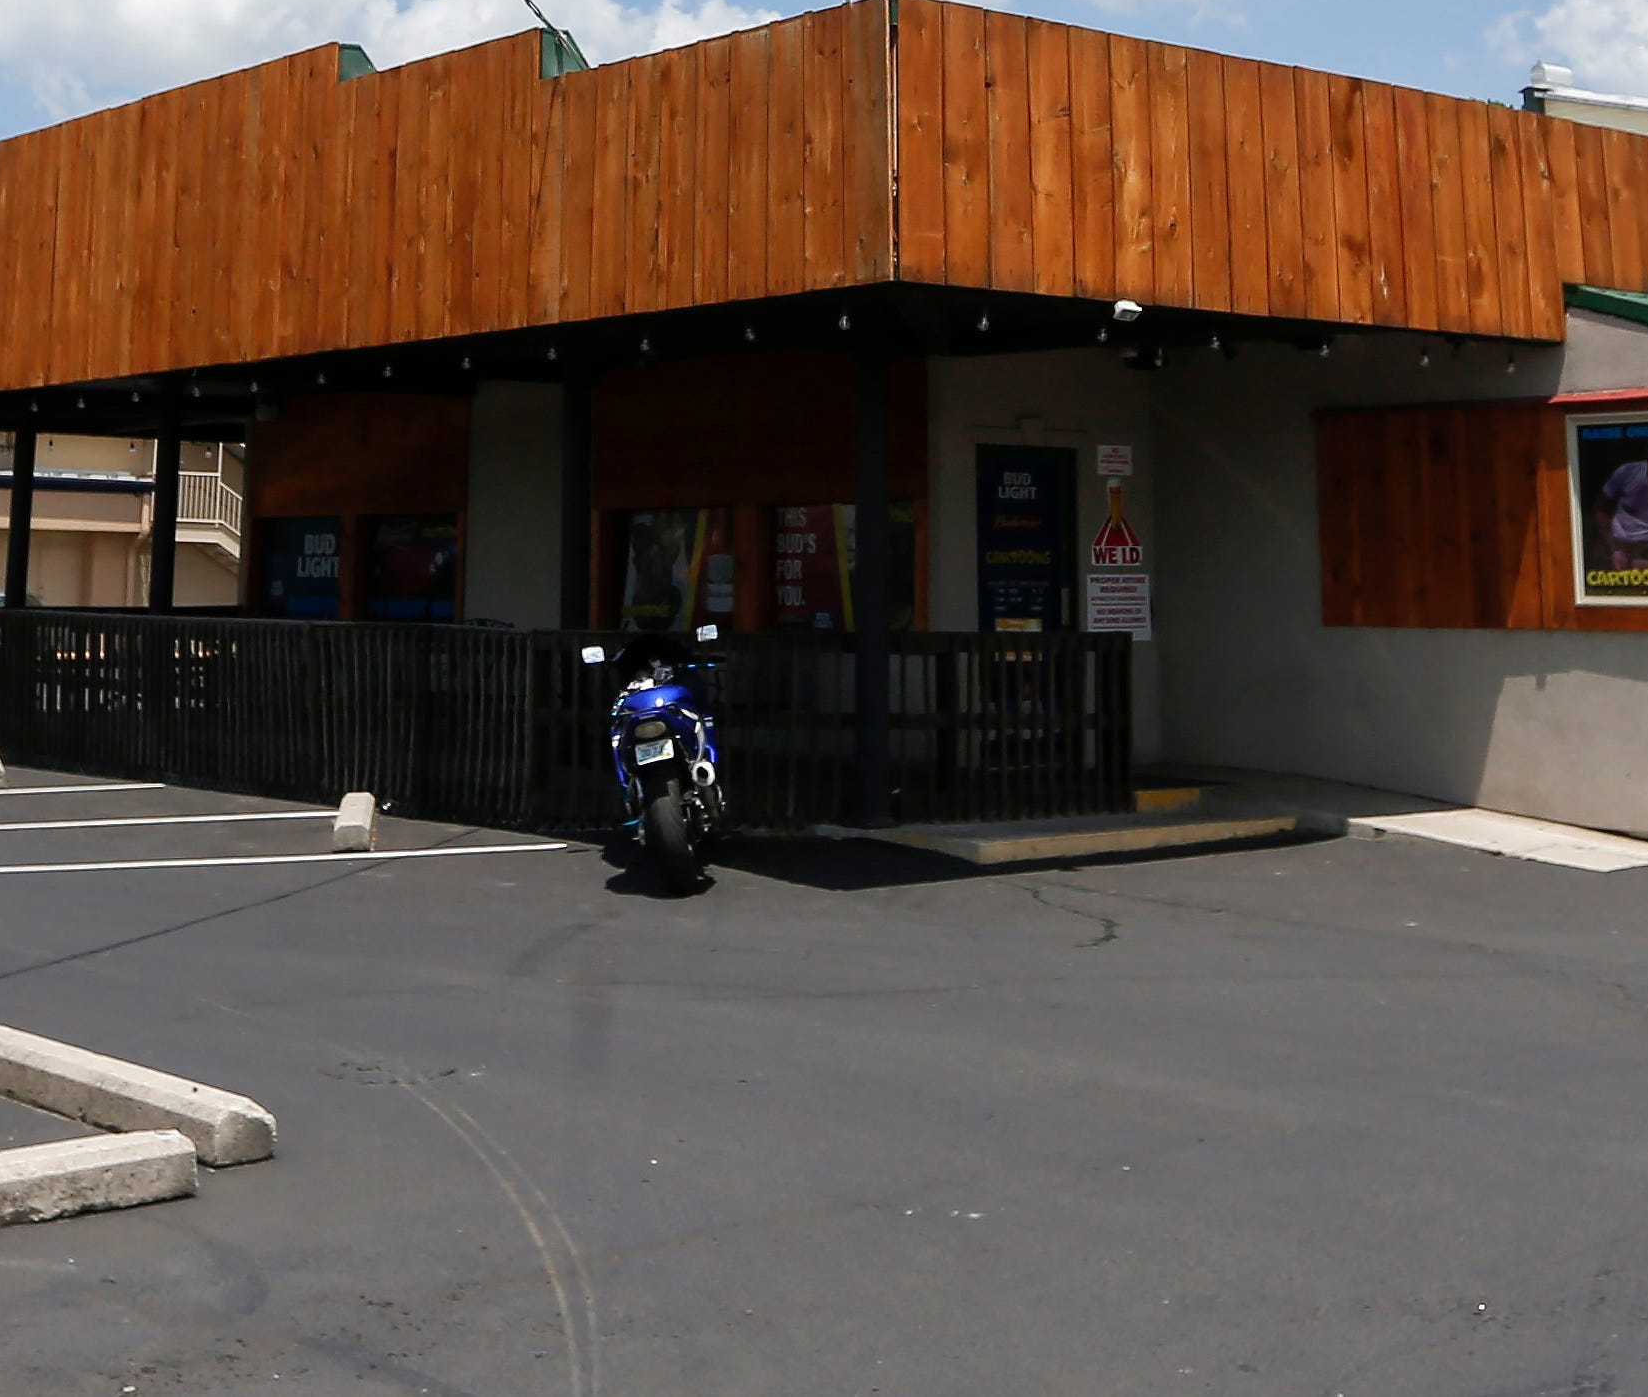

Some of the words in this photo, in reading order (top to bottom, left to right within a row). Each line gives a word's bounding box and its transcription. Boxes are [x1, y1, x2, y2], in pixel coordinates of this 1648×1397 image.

[1004, 471, 1031, 486] BUD
[998, 486, 1037, 500] LIGHT
[776, 506, 807, 527] THIS
[304, 533, 336, 554] BUD
[776, 532, 816, 554] BUD'S
[1093, 547, 1117, 564] WE
[297, 557, 340, 578] LIGHT
[776, 559, 803, 580] FOR
